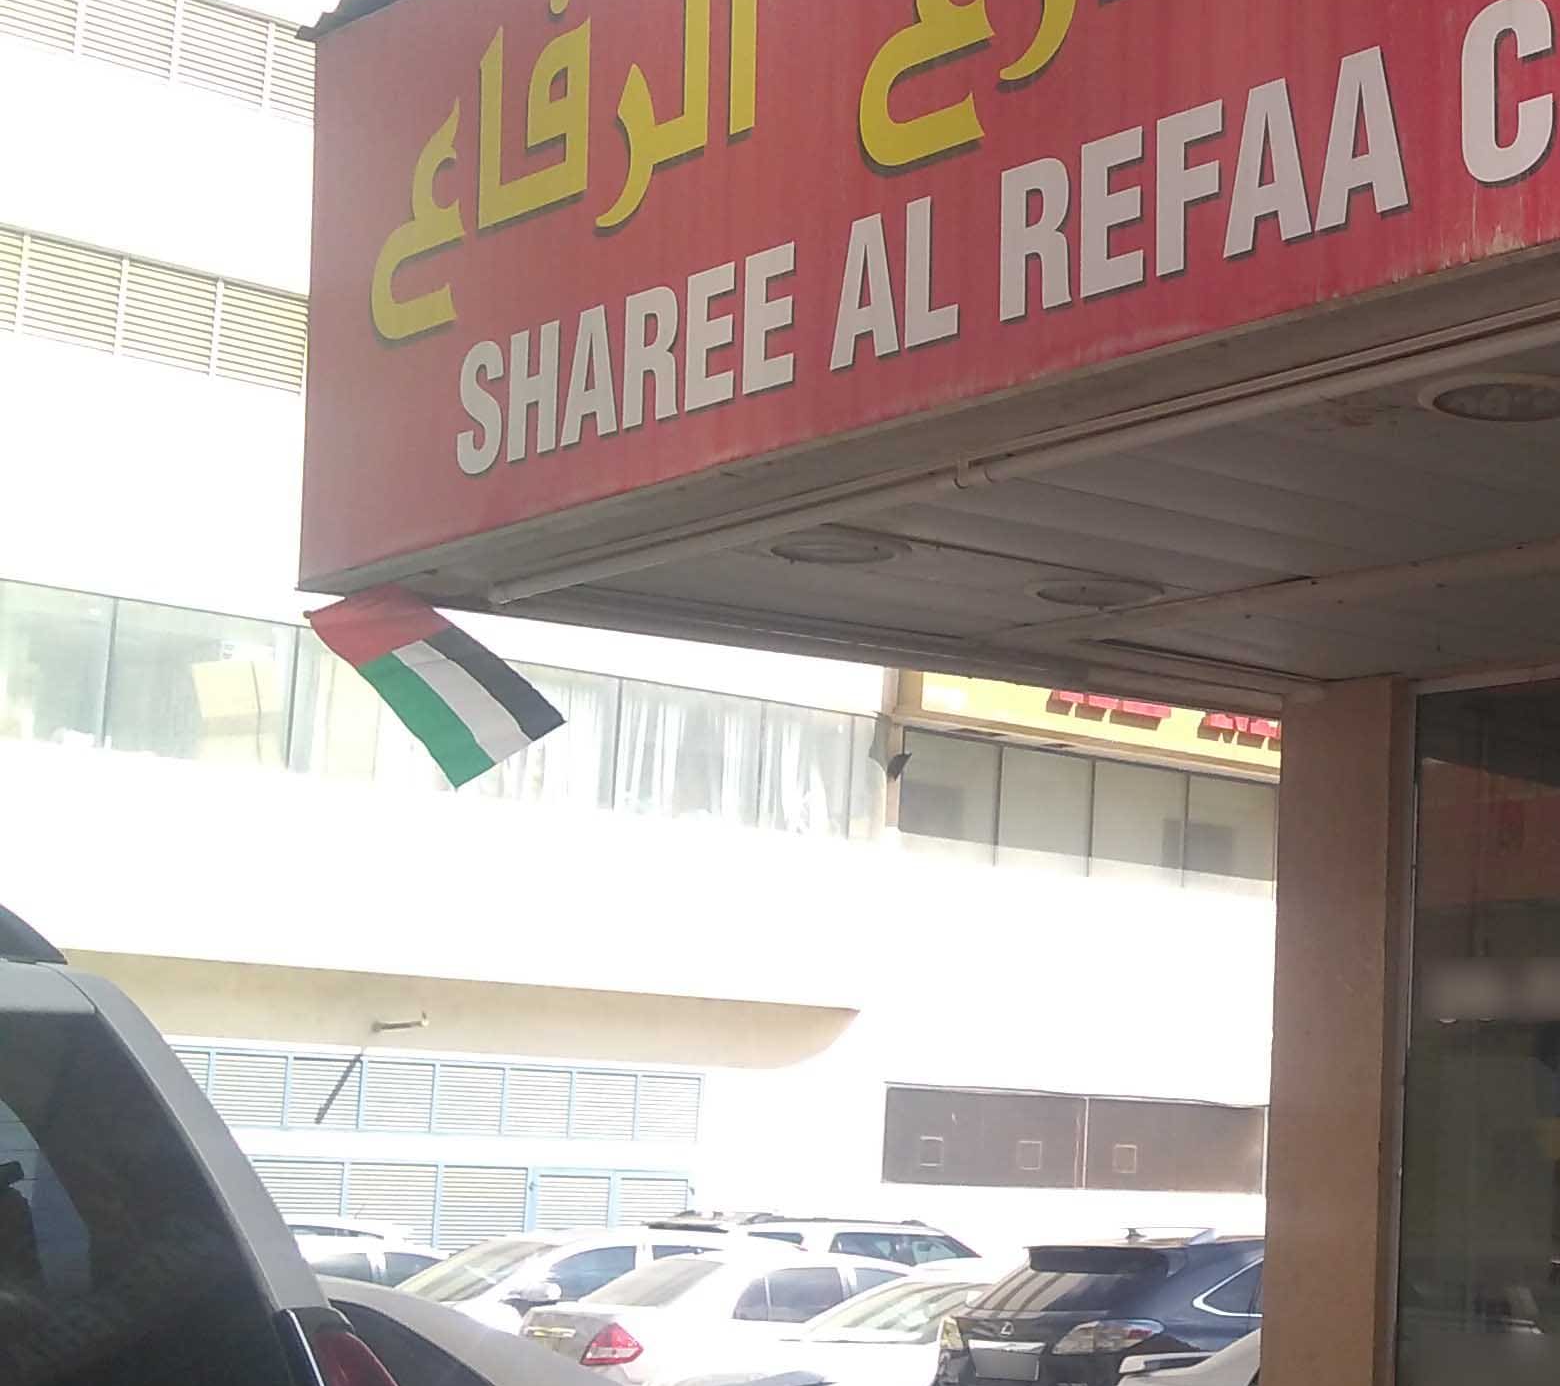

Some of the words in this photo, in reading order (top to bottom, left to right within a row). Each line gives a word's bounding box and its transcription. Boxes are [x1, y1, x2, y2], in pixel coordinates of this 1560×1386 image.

[456, 242, 797, 476] SHAREE
[830, 196, 959, 371] AL
[999, 46, 1410, 321] REFAA
